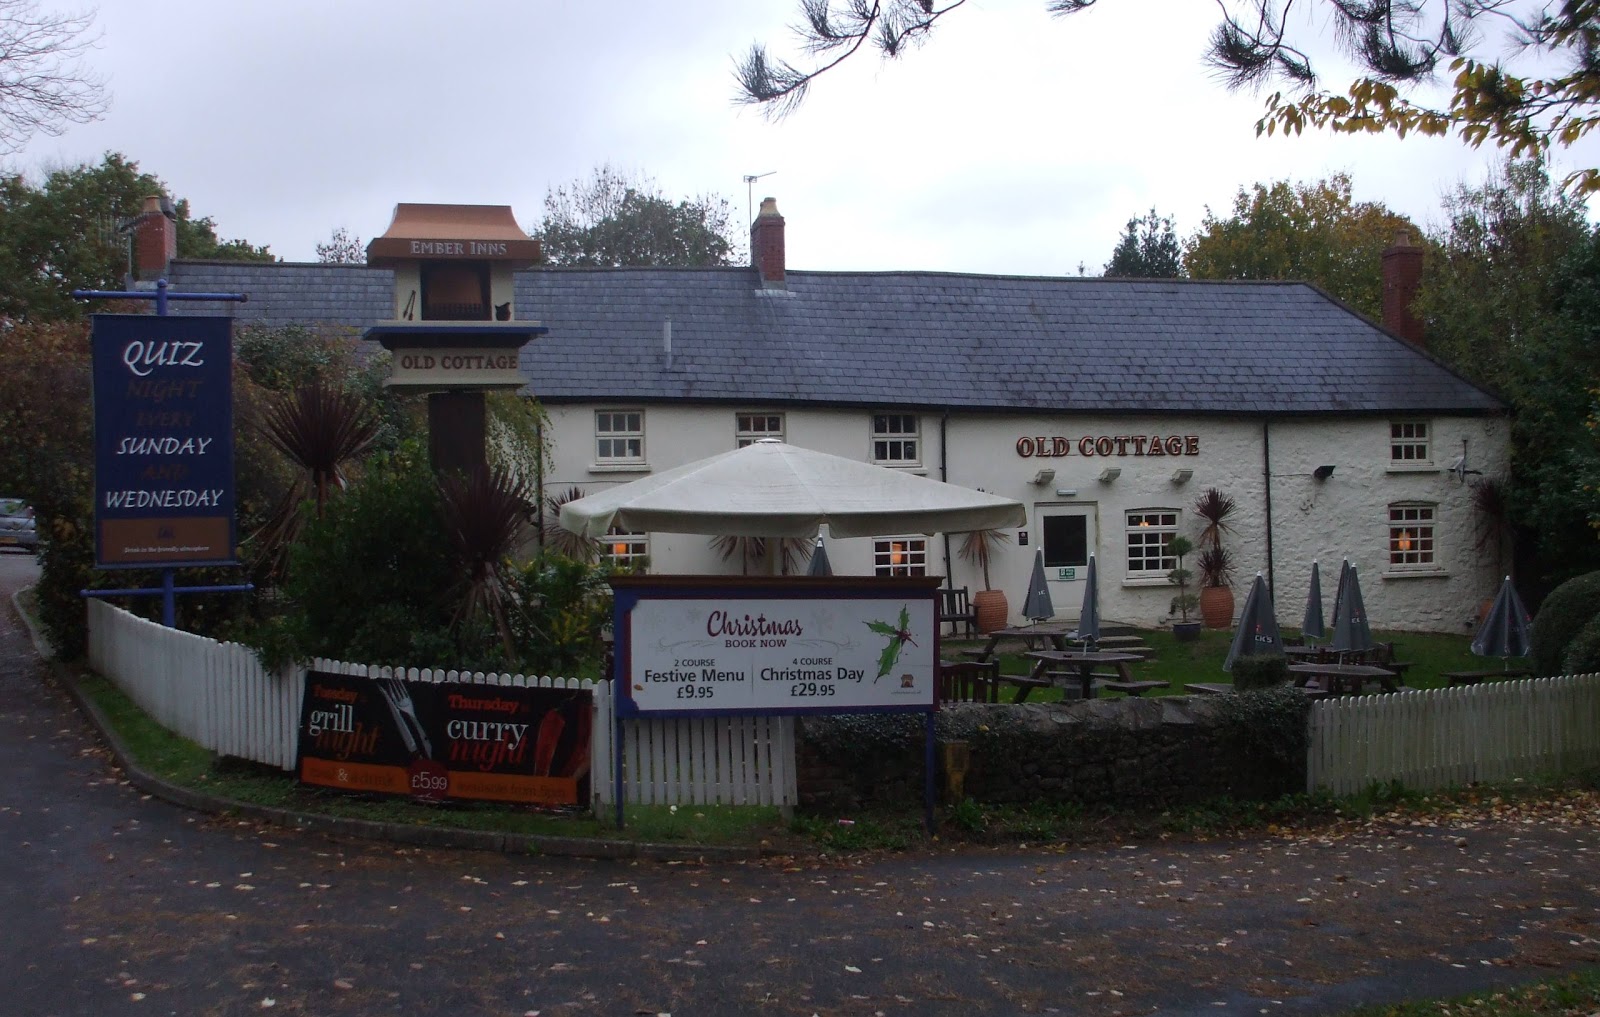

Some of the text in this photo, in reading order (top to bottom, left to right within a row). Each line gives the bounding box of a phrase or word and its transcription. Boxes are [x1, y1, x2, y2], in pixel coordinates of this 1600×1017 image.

[410, 240, 507, 256] EMBER INNS
[123, 340, 204, 376] QUIZ
[401, 355, 518, 370] OLD COTTAGE
[127, 379, 203, 402] NIGHT
[117, 437, 212, 455] SUNDAY
[1016, 435, 1200, 457] OLD COTTAGE
[105, 489, 224, 508] WEDNESDAY
[706, 610, 804, 637] Christmas
[725, 639, 788, 648] BOOK NOW
[674, 659, 716, 667] 2 COURSE
[792, 657, 833, 665] 4 COURSE
[644, 669, 745, 683] Festive Menu
[760, 668, 865, 683] Christmas Day
[676, 685, 714, 699] £9.95
[790, 683, 836, 697] £29.95
[448, 693, 520, 716] Thursday
[309, 704, 354, 736] grill
[447, 719, 529, 750] curry
[411, 771, 448, 790] £5.99
